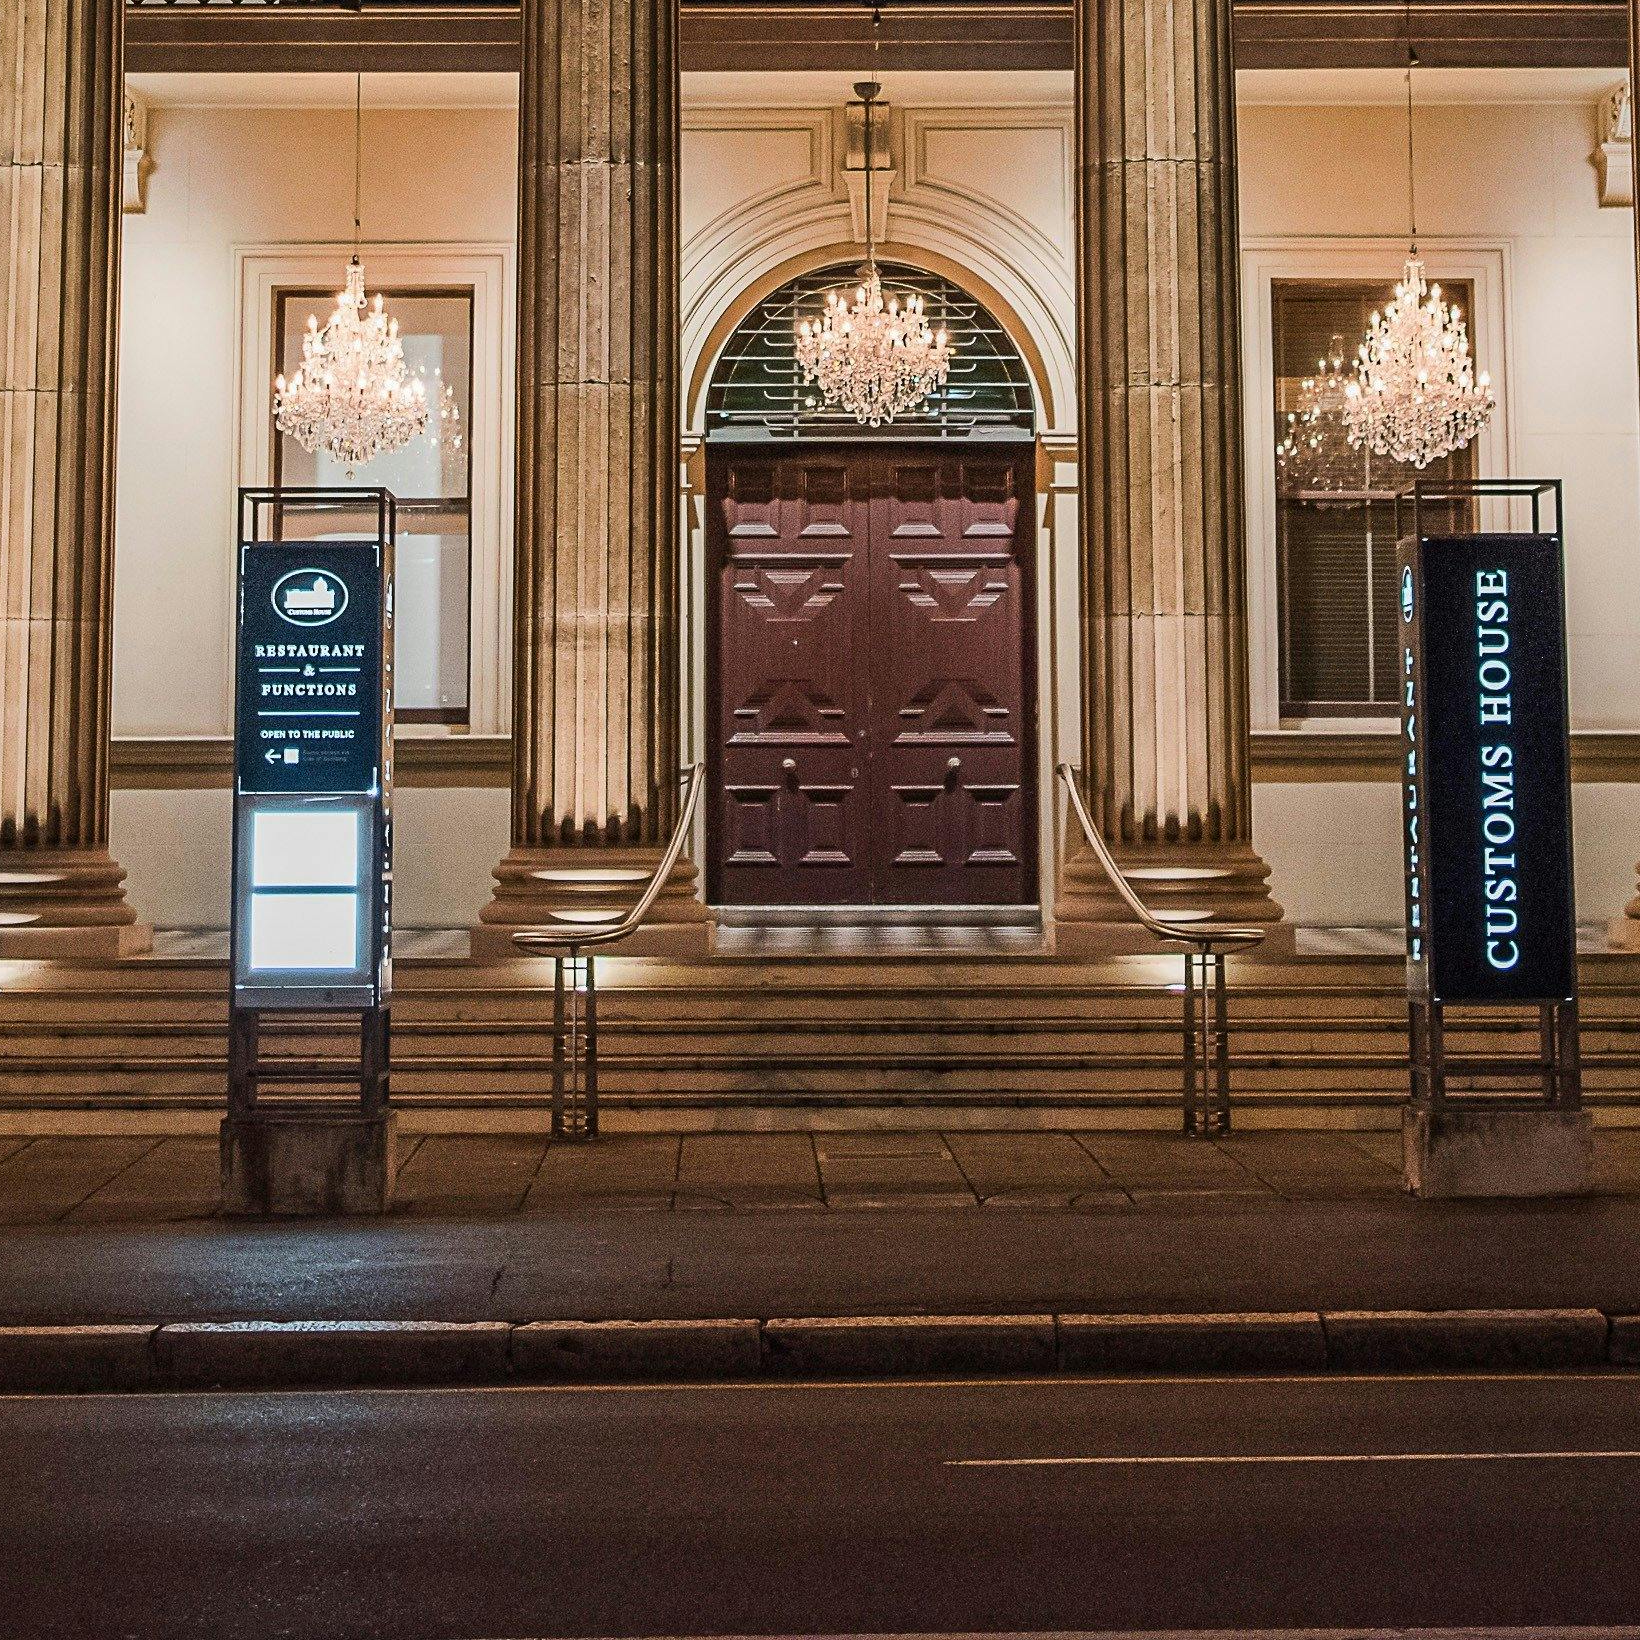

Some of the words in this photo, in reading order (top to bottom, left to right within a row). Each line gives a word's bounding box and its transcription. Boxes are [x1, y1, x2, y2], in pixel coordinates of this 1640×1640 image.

[254, 644, 365, 657] RESTAURANT
[1476, 569, 1512, 725] HOUSE
[303, 663, 316, 677] &
[261, 683, 357, 696] FUNCTIONS
[260, 729, 286, 739] OPEN
[288, 729, 301, 739] TO
[303, 729, 320, 739] THE
[321, 729, 355, 739] PUBLIC
[1481, 744, 1519, 969] CUSTOMS
